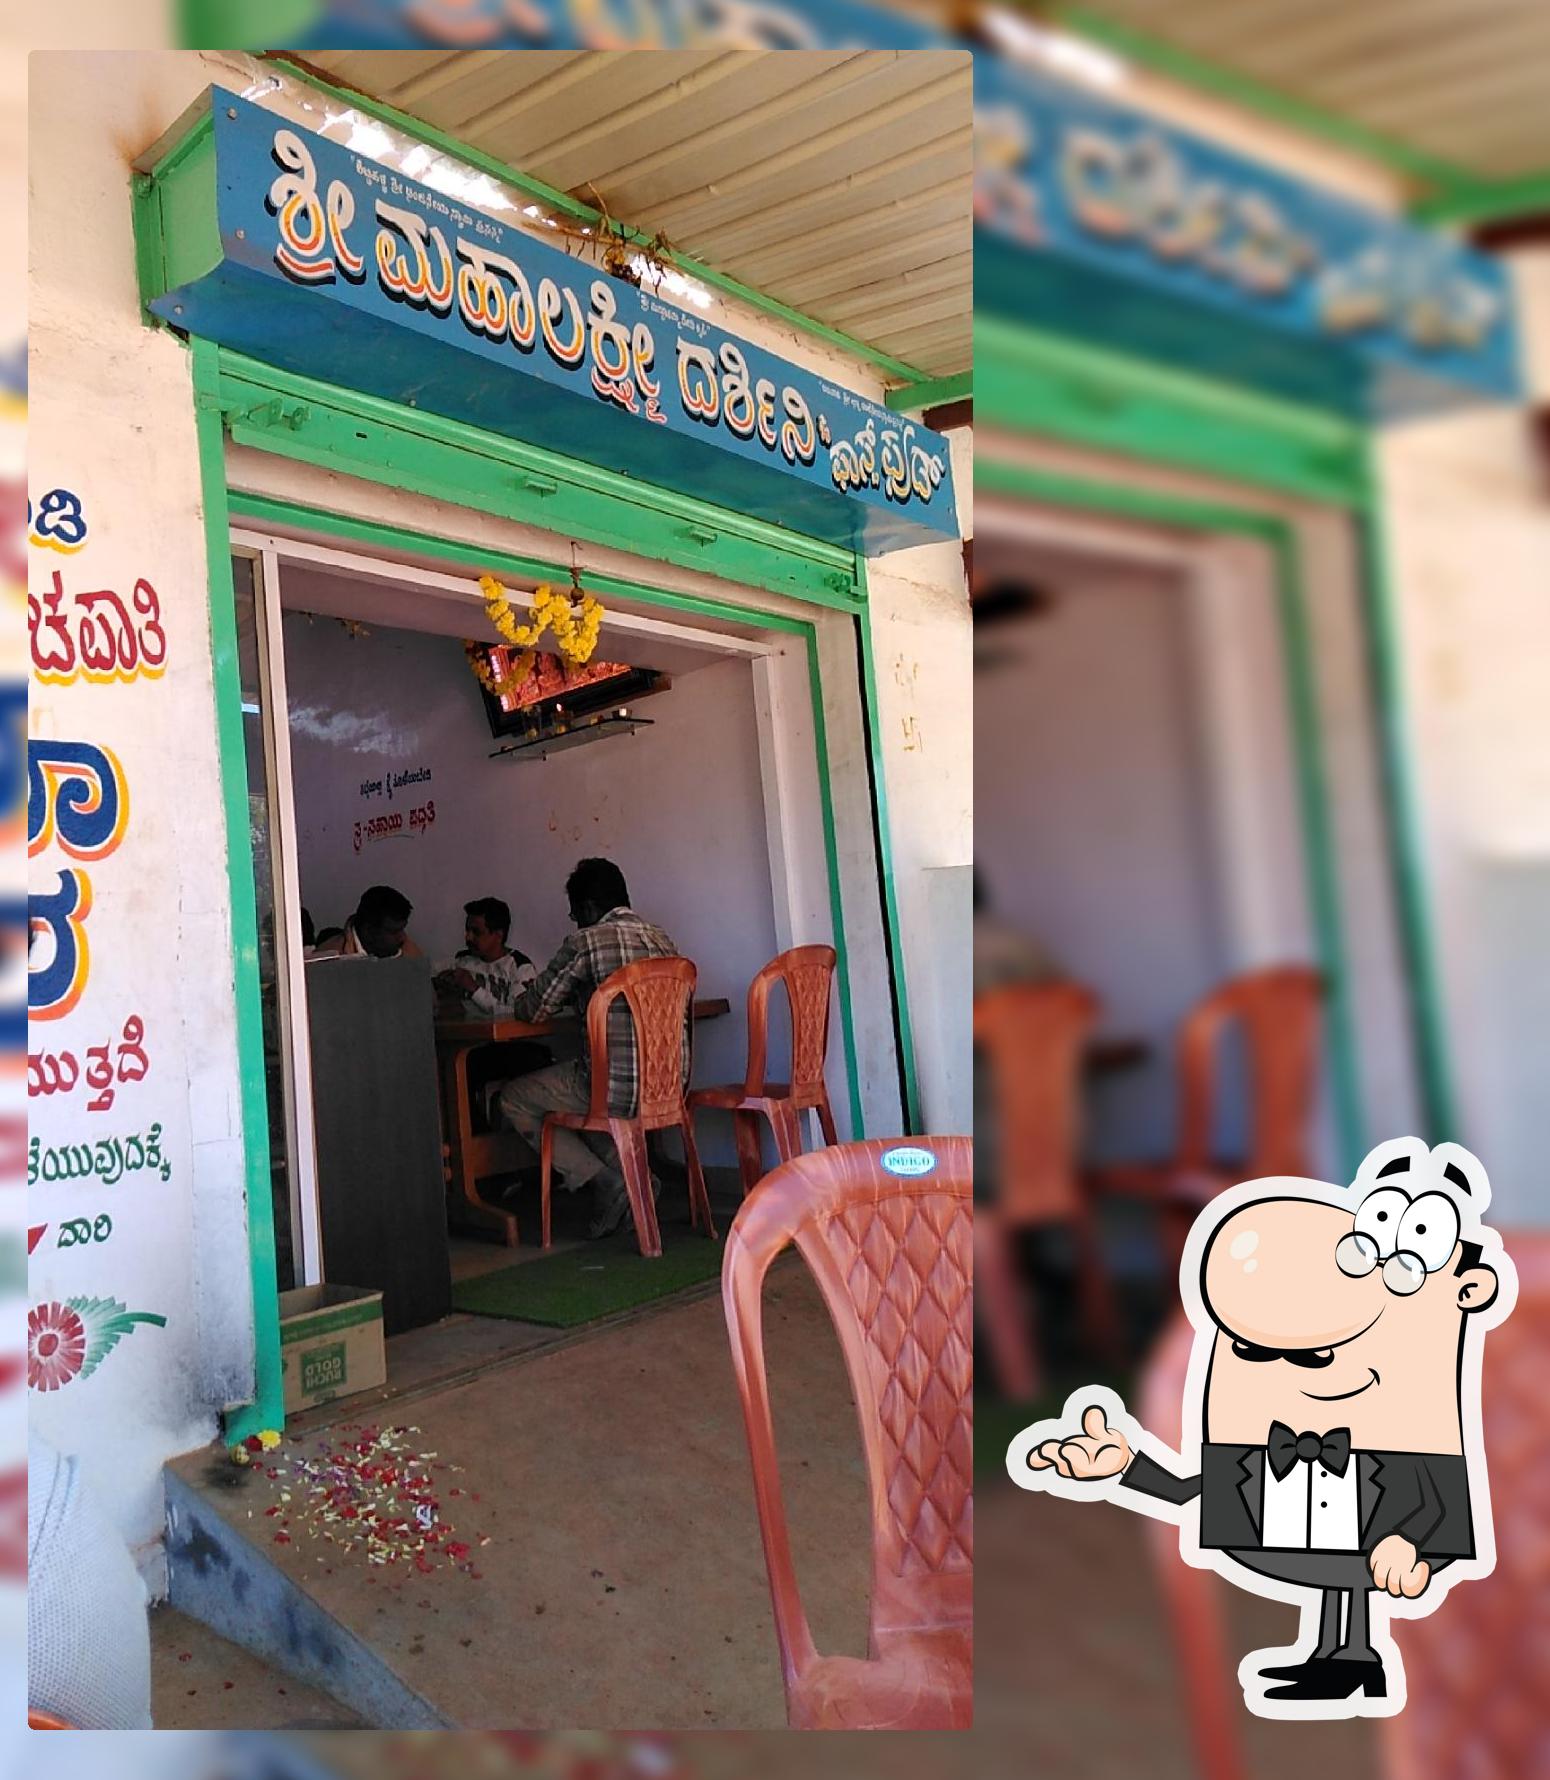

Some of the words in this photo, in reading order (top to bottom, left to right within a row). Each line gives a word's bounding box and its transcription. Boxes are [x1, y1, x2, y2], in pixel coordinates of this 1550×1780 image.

[266, 129, 365, 283] ಶ್ರೀ
[676, 336, 816, 466] ದರ್ಶಿನಿ
[28, 489, 87, 546] ಡಿ
[57, 1213, 112, 1248] ದಾರಿ
[305, 1356, 341, 1376] GOLD
